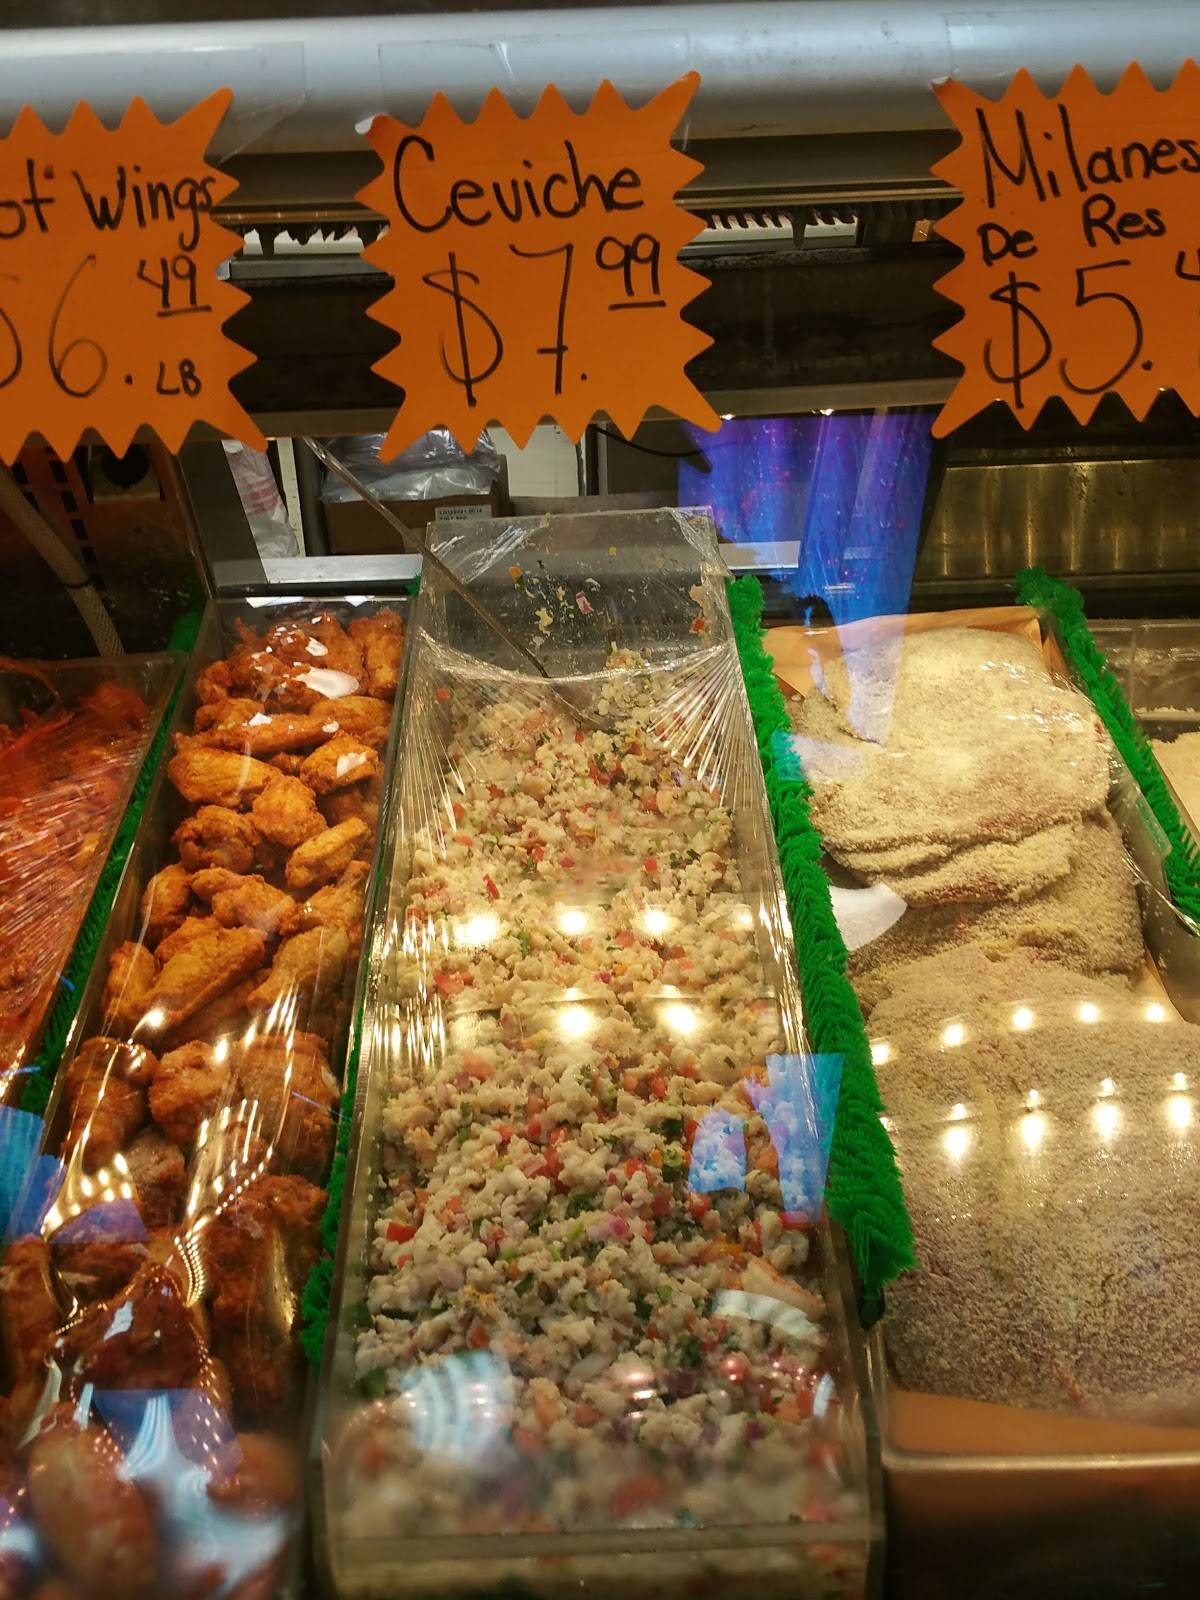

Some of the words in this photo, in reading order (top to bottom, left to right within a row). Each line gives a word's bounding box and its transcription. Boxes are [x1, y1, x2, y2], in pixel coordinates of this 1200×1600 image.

[72, 165, 216, 251] Wings
[393, 135, 644, 233] Ceviche
[977, 222, 1038, 268] De
[1082, 193, 1167, 247] Res
[155, 358, 201, 397] LB
